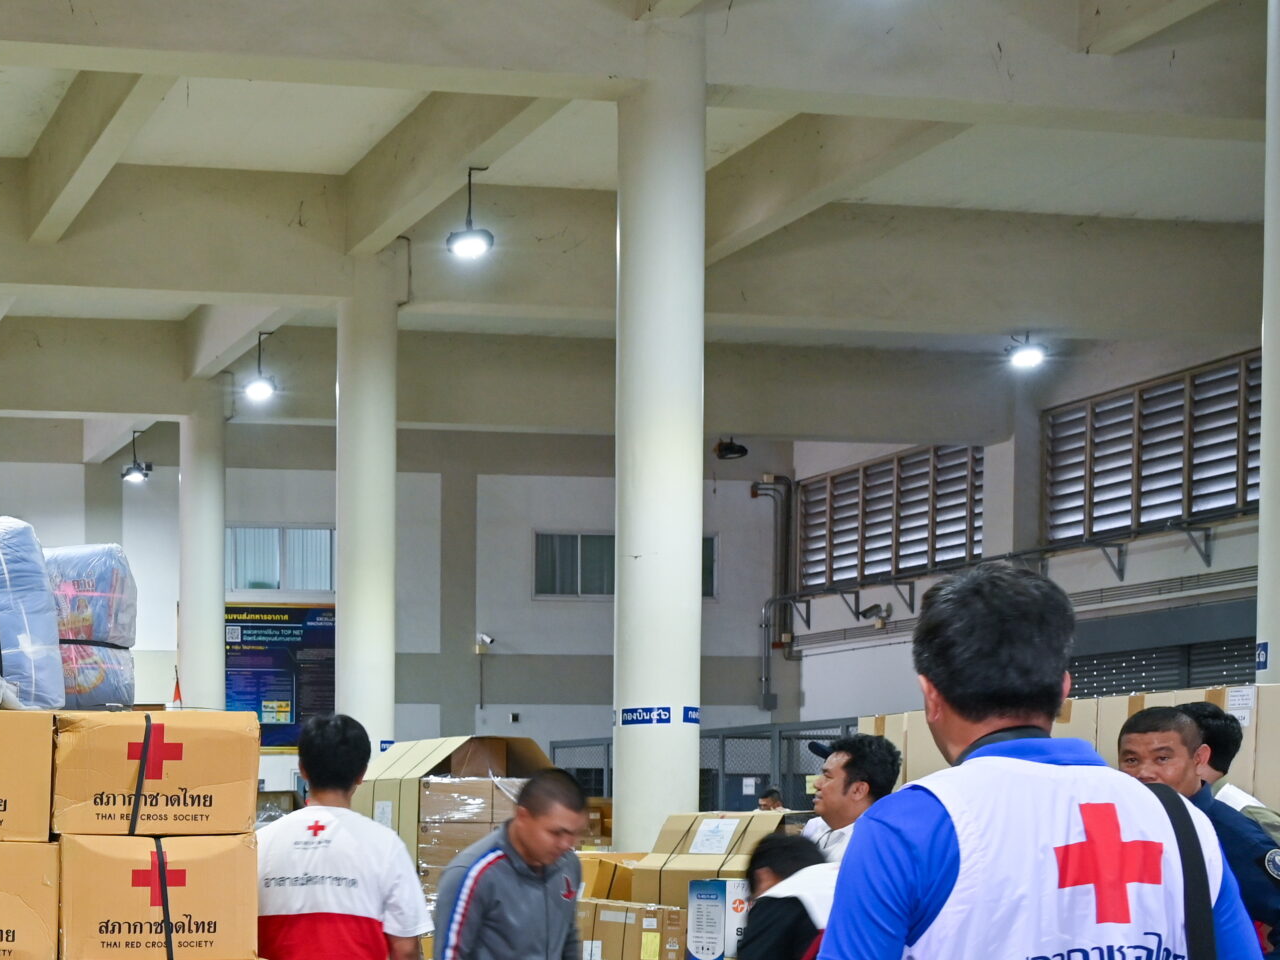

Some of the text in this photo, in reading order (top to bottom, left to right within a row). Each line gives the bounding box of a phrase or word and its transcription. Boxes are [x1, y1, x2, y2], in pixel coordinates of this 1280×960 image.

[95, 812, 210, 822] THAI RE CROSS SOCIETY
[100, 940, 214, 949] THAI RED CROS SOCIETY
